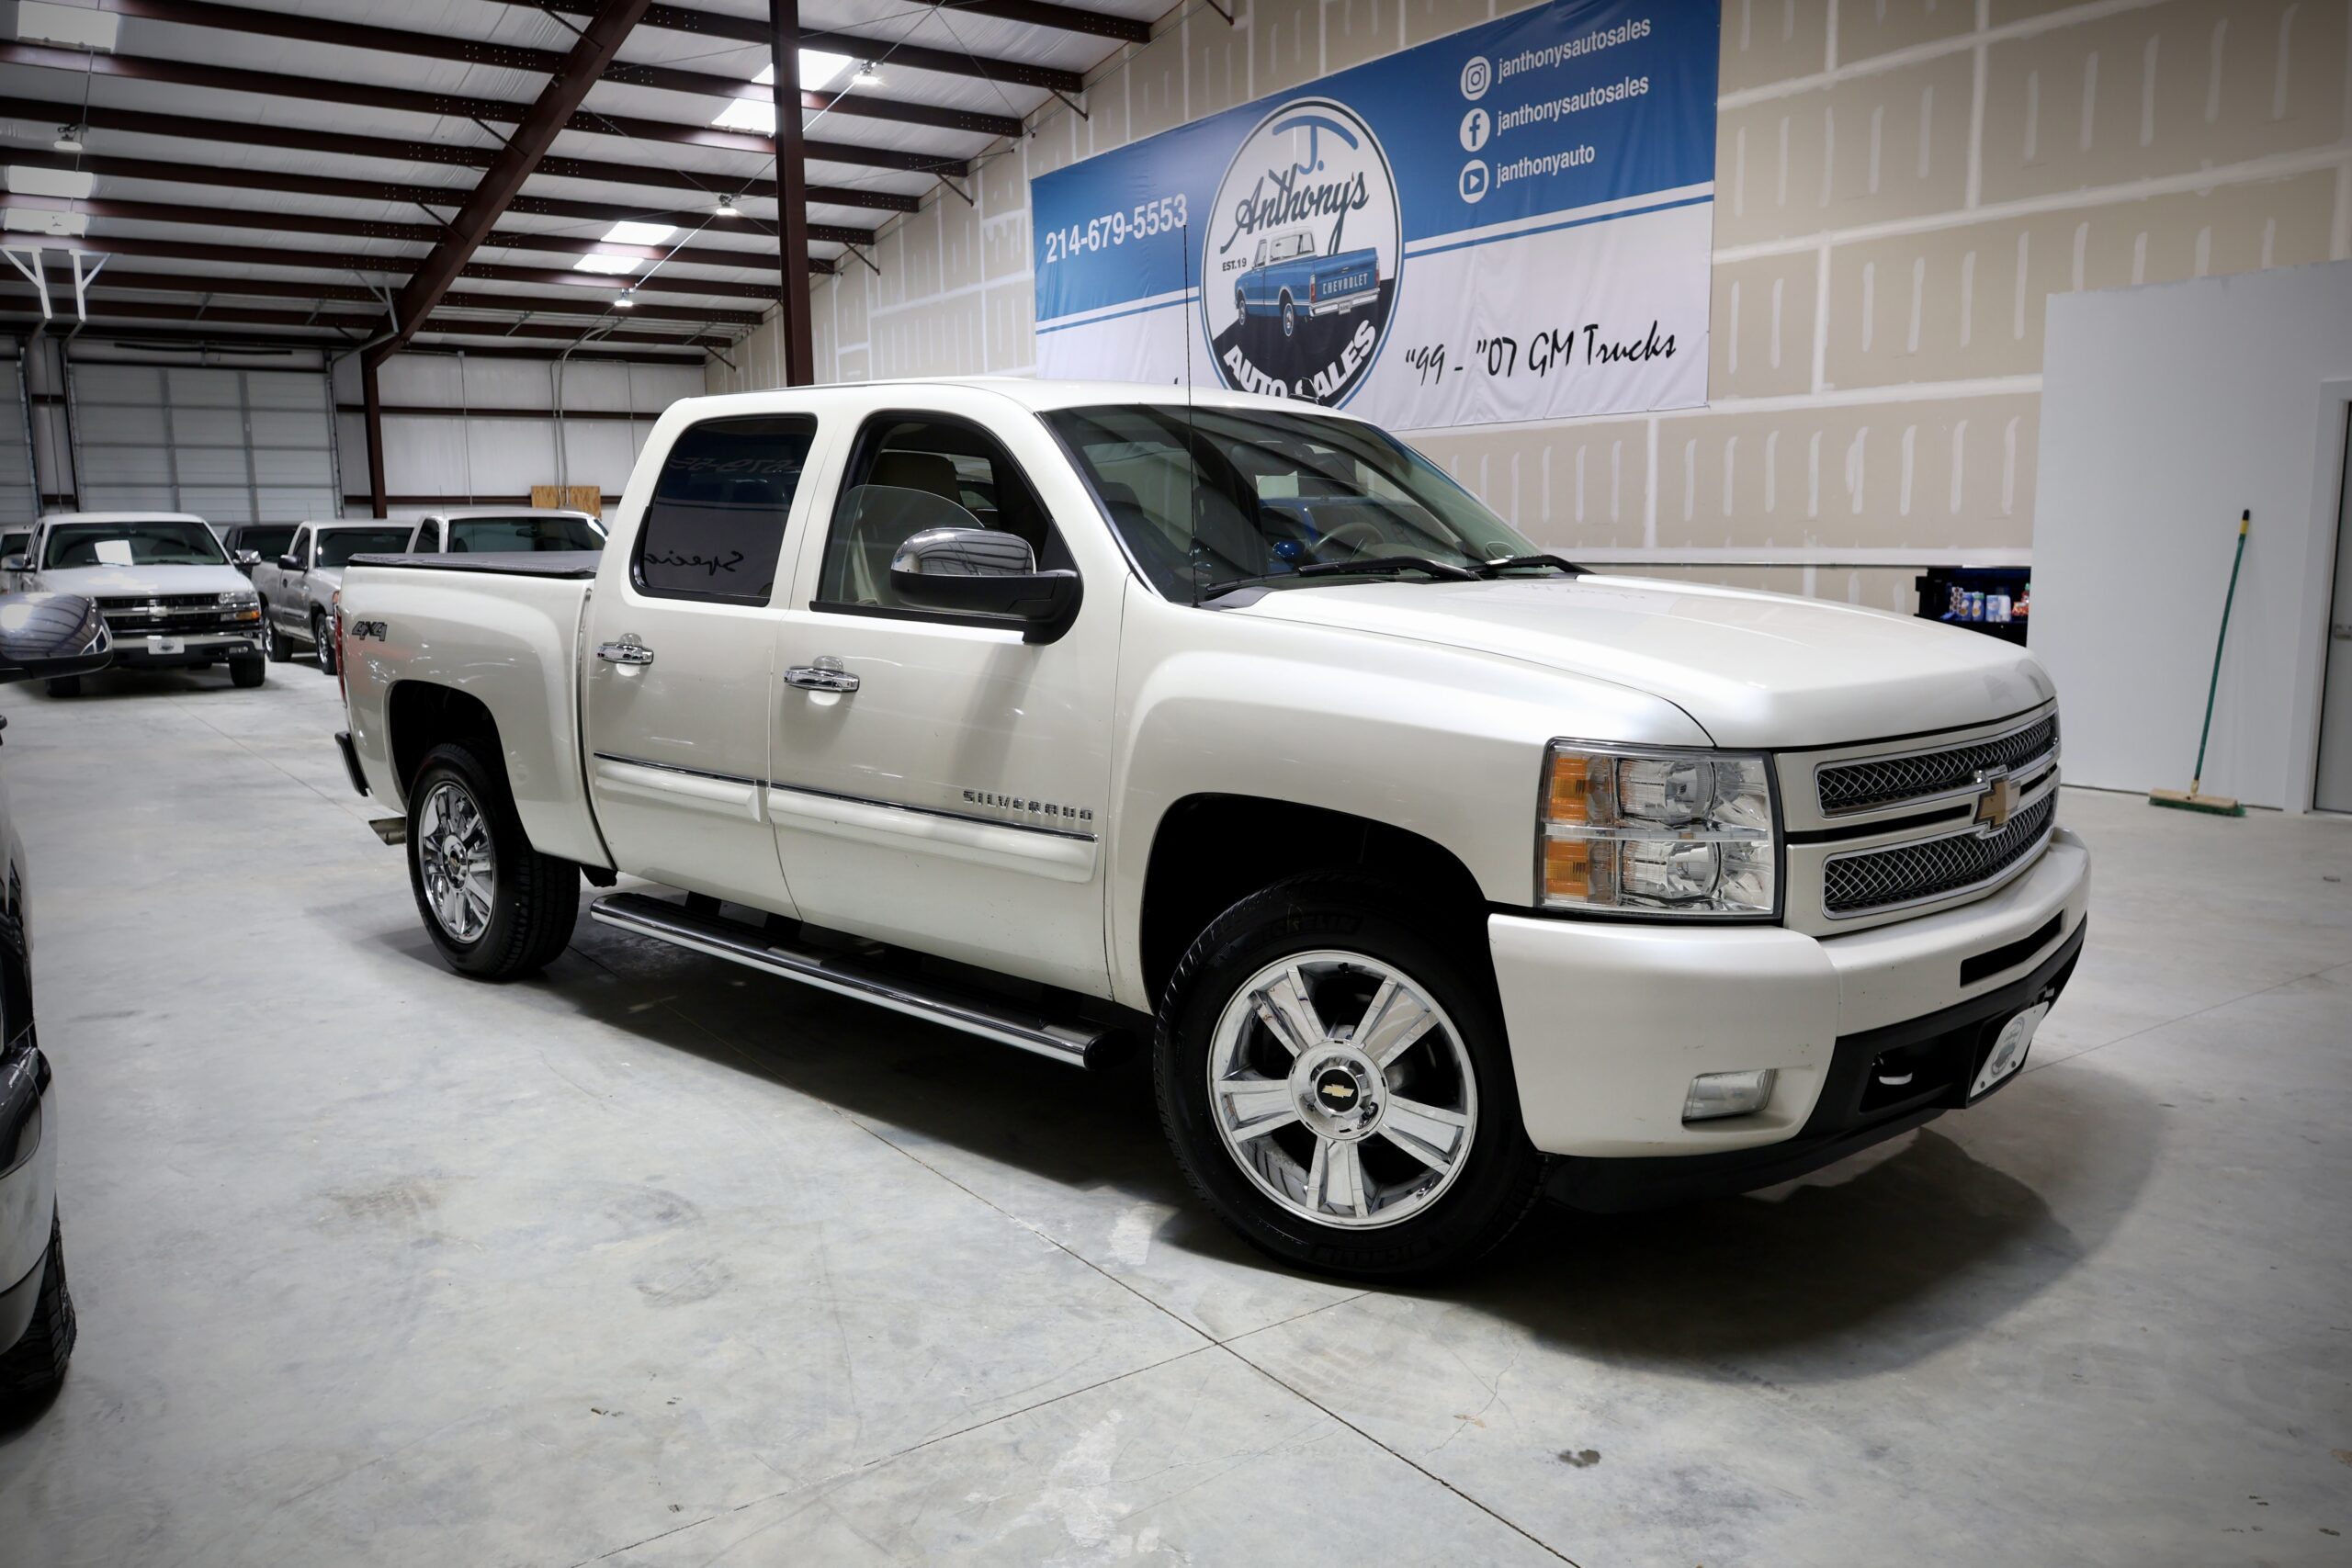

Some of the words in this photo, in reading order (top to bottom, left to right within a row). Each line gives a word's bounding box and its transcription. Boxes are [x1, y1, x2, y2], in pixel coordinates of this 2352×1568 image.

[1498, 18, 1651, 84] janthonysautosales
[1497, 75, 1649, 136] janthonysautosales
[1497, 144, 1595, 188] janthonyauto
[1046, 193, 1187, 263] 214-679-5553
[1220, 163, 1369, 256] Anthony's
[1322, 273, 1368, 295] CHEVROLET
[1529, 328, 1574, 378] GM
[1584, 320, 1676, 365] Trucks
[963, 790, 1094, 823] SILVERADO
